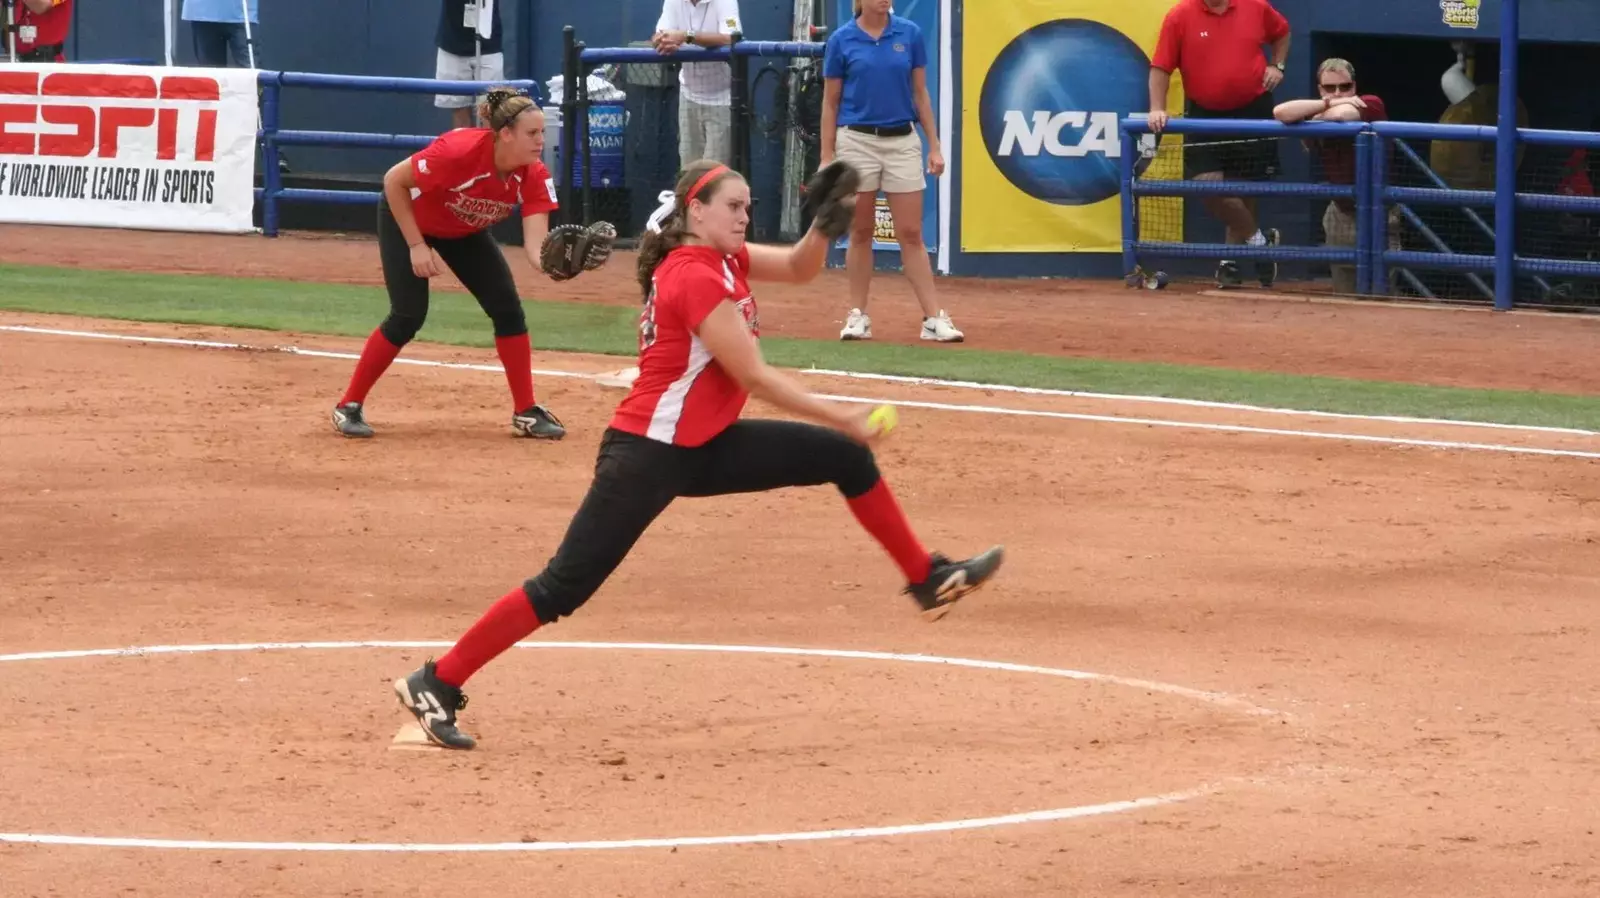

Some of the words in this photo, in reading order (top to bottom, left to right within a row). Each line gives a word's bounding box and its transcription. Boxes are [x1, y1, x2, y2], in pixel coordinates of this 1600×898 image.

[1445, 13, 1477, 22] Series
[1446, 7, 1476, 16] World
[0, 71, 220, 161] ESPN
[9, 163, 88, 200] WORLDWIDE
[91, 166, 140, 201] LEADER
[142, 168, 160, 203] IN
[162, 169, 216, 205] SPORTS
